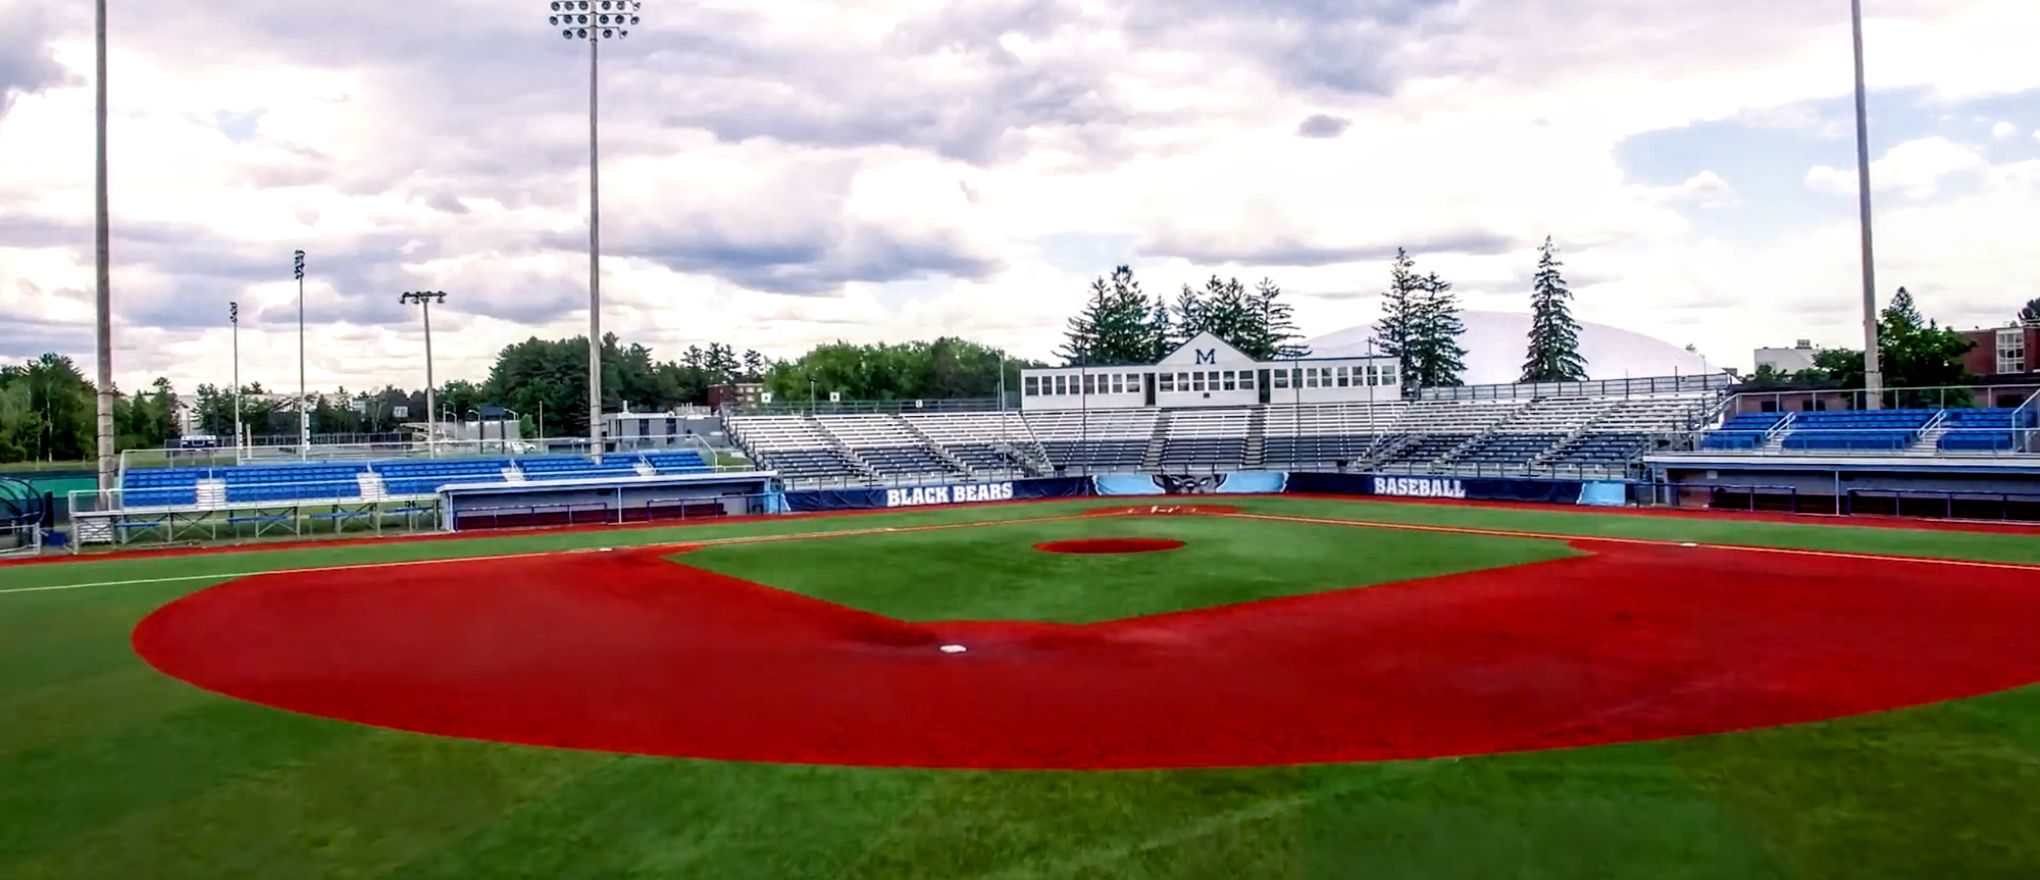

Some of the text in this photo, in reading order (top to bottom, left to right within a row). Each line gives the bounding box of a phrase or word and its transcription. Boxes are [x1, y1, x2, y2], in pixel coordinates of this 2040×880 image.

[1195, 348, 1216, 365] M
[886, 481, 1013, 507] BLACK BEARS
[1374, 477, 1466, 499] BASEBALL
